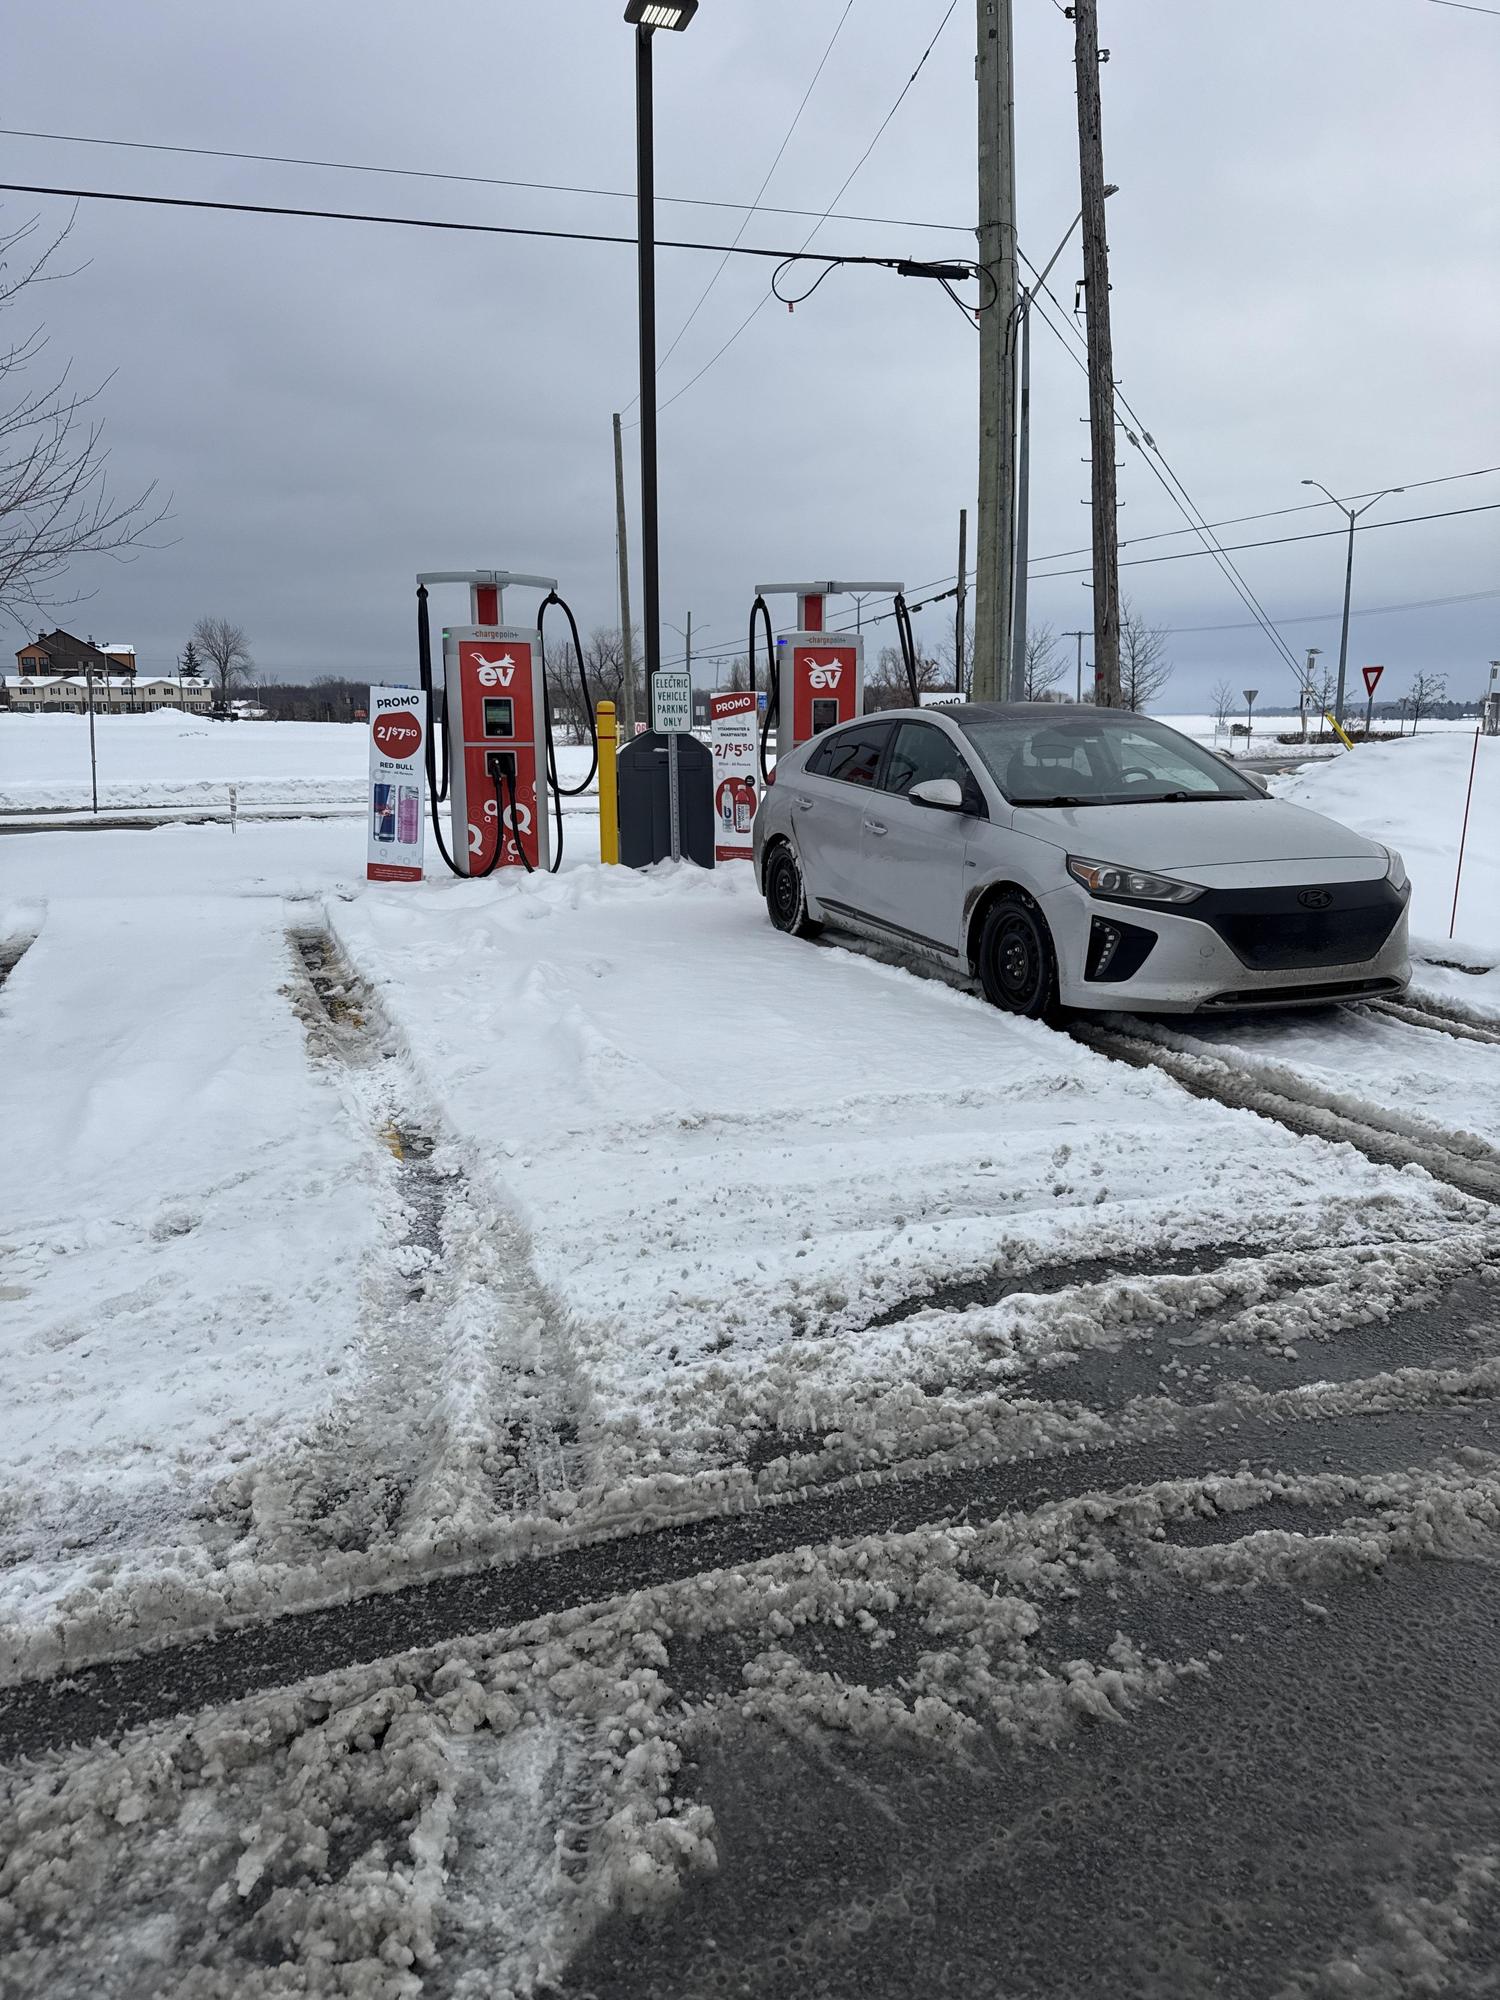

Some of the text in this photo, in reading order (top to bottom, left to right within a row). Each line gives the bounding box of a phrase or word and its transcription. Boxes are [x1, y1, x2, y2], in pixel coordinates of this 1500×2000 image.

[656, 678, 688, 689] ELECTRIC
[657, 691, 687, 701] VEHICLE
[376, 695, 420, 709] PROMO
[715, 697, 751, 713] PROMO
[657, 704, 688, 714] PARKING
[663, 717, 682, 727] ONLY
[379, 761, 414, 771] RED BULL
